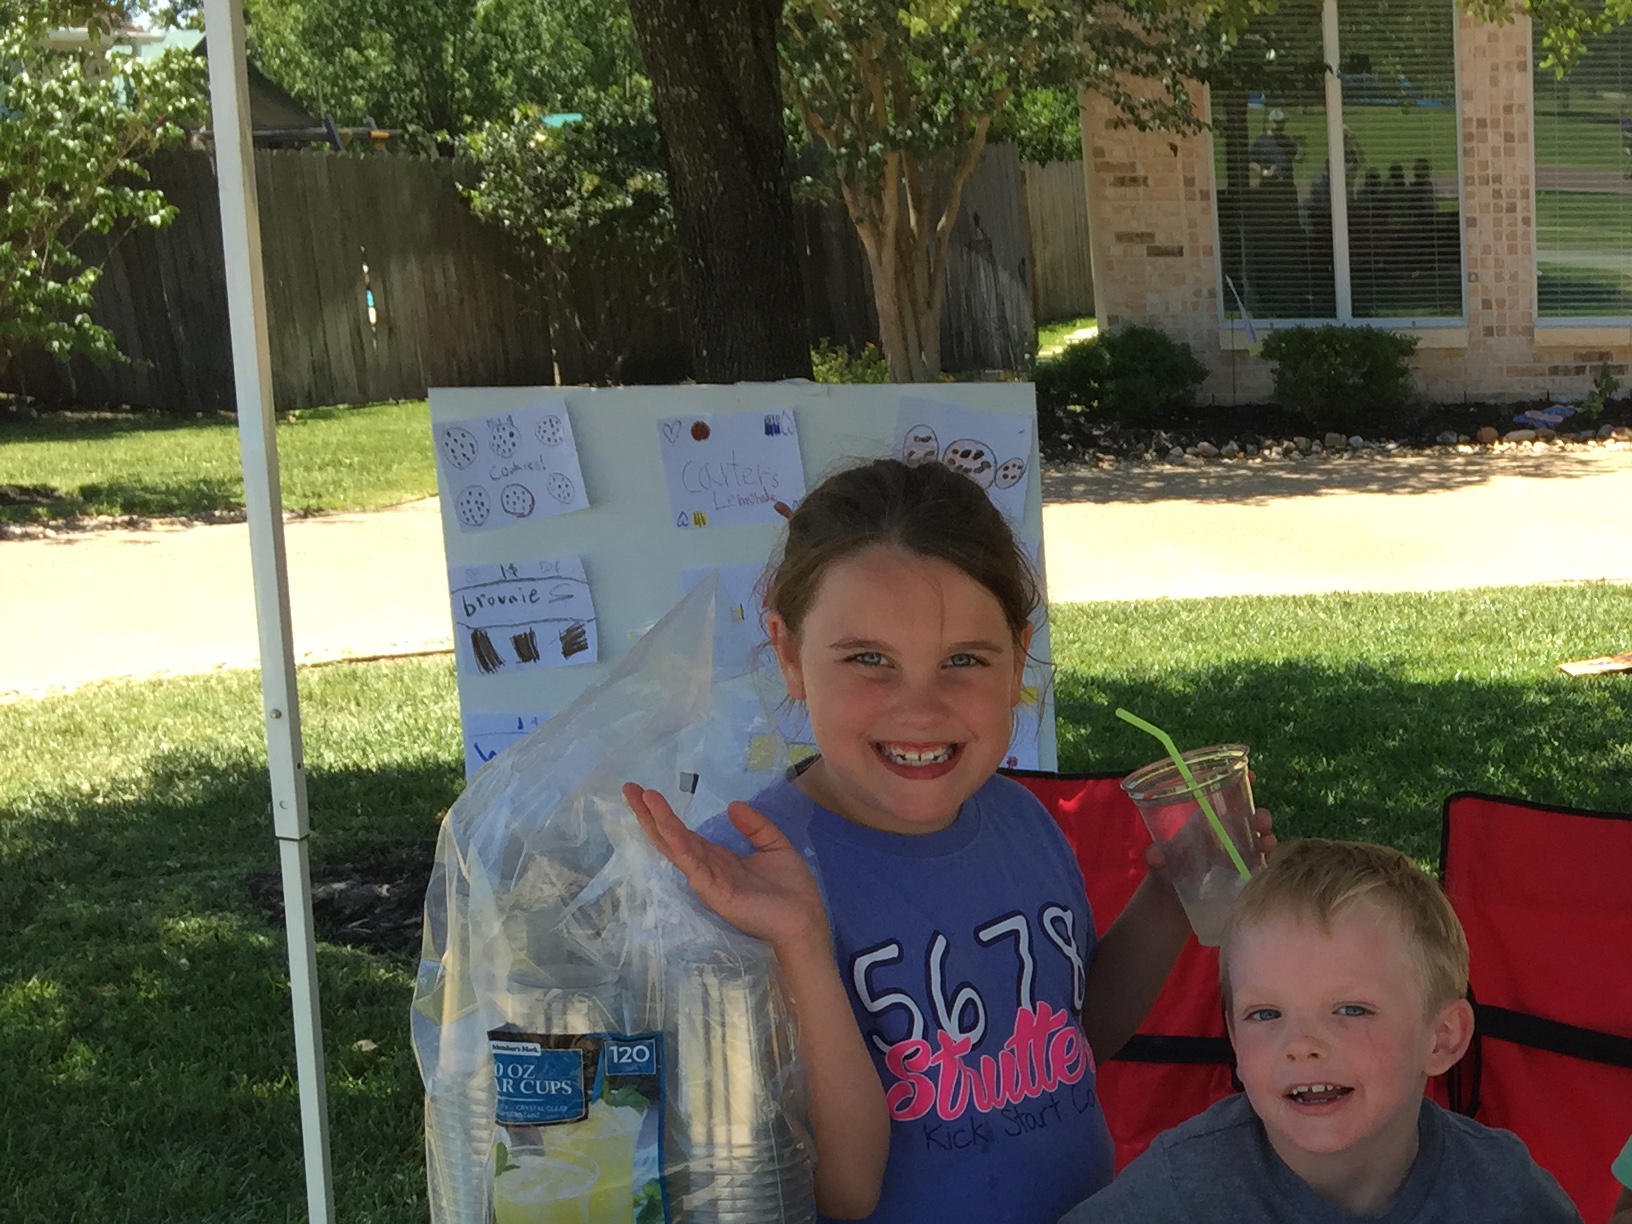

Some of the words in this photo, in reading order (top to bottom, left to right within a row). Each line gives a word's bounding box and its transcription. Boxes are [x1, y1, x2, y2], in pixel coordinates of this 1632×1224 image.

[609, 1045, 650, 1063] 120
[507, 1064, 536, 1079] OZ
[519, 1080, 572, 1095] CUPS
[923, 1116, 992, 1150] Kick
